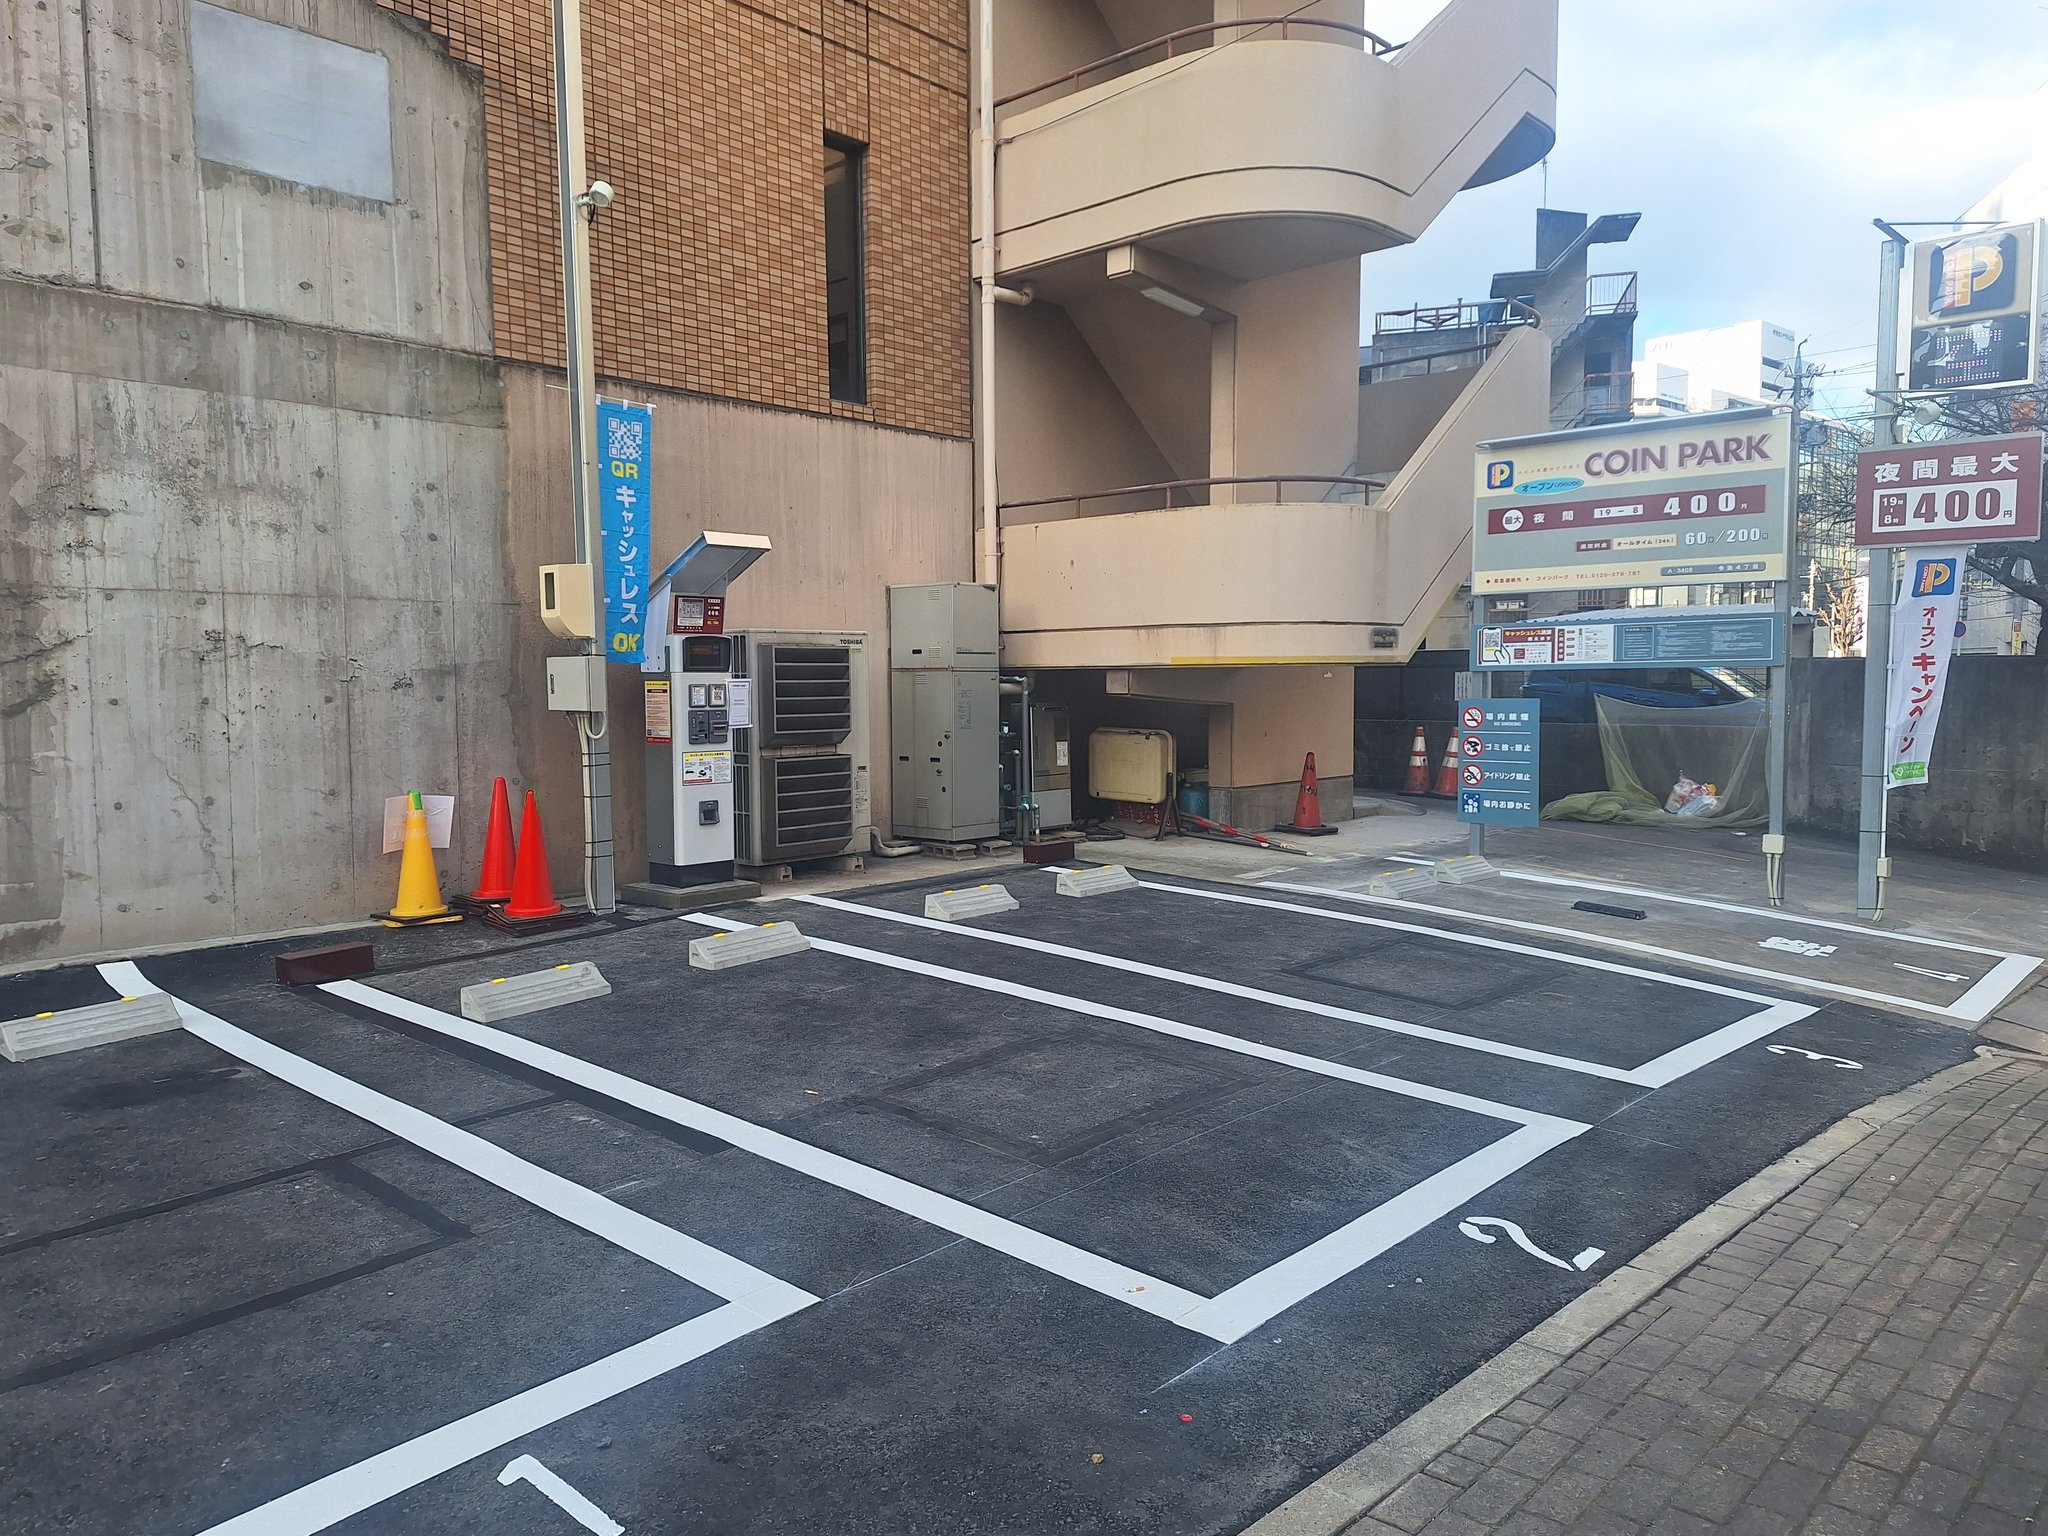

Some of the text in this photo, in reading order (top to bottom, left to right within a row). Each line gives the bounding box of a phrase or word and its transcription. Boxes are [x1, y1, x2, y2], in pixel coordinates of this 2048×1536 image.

[610, 460, 639, 479] QR
[1584, 433, 1772, 477] COIN PARK
[1873, 451, 2020, 483] 夜間最大
[1912, 487, 2013, 524] 400円
[615, 485, 640, 625] キャッシュレス
[612, 632, 640, 653] OK
[1457, 1216, 1606, 1273] 2
[496, 1453, 626, 1536] 1
